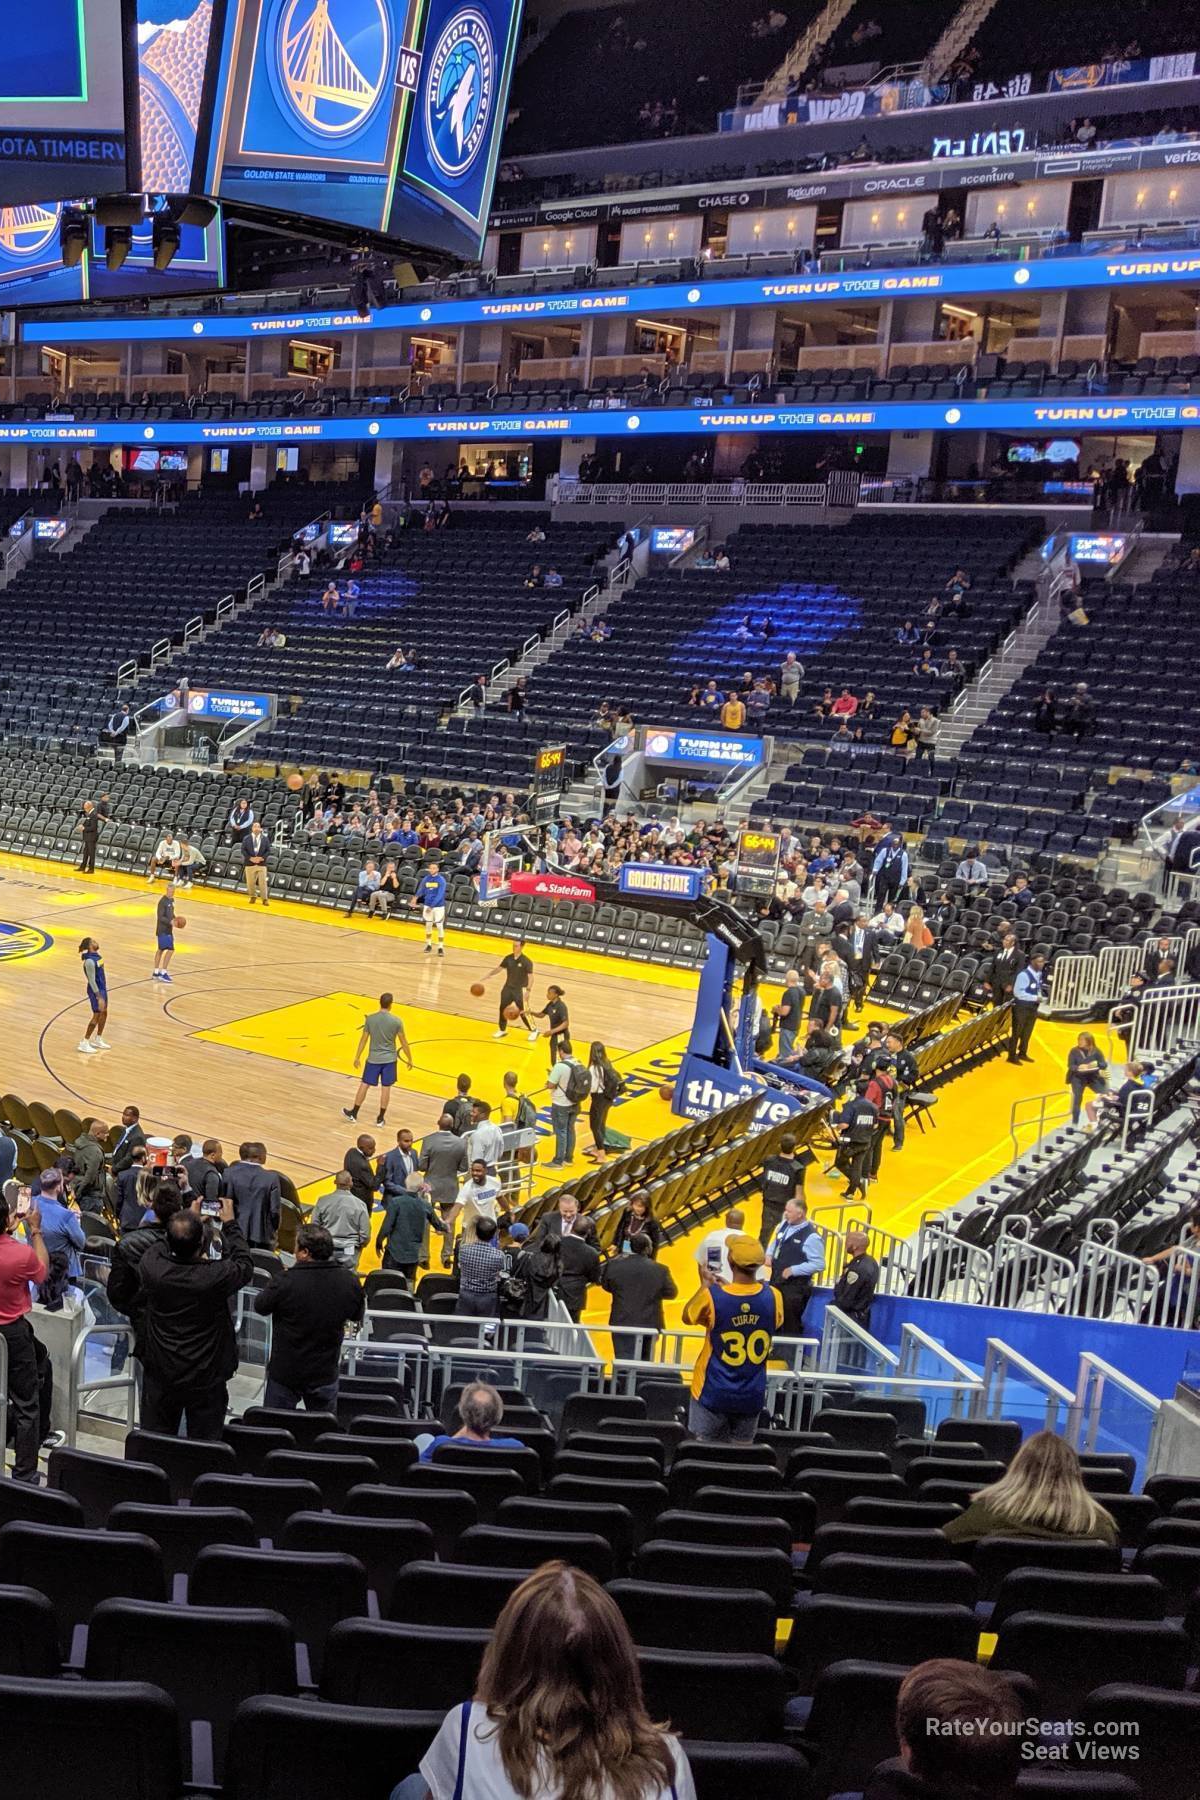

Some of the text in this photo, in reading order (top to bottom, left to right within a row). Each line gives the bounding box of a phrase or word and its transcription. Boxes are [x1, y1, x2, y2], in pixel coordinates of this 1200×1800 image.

[400, 52, 418, 85] VS
[430, 24, 469, 102] MINNESOTA
[1164, 150, 1200, 164] veriz
[244, 170, 326, 181] GOLDEN STATE WARRIORS
[960, 170, 1014, 185] accenture
[864, 176, 925, 191] ORACLE
[787, 186, 827, 199] Rakuten
[698, 195, 737, 207] CHASE
[501, 216, 533, 224] AIRLINES
[545, 208, 598, 222] Google Cloud
[1106, 260, 1200, 276] TURN UP
[762, 275, 940, 296] TURN UP THE GAME
[482, 296, 627, 314] TURN UP THE GAME
[251, 314, 371, 330] TURN UP THE GAME
[700, 412, 873, 425] TURN UP THE GAME
[1034, 408, 1094, 420] TURN
[1097, 407, 1128, 419] UP
[1131, 406, 1176, 419] THE
[203, 425, 321, 437] TURN UP THE GAME
[428, 419, 568, 431] TURN UP THE GAME
[11, 428, 28, 437] UP
[30, 429, 55, 437] THE
[58, 429, 95, 437] GAME
[210, 697, 255, 708] TURN UP
[679, 738, 743, 752] TURN UP
[679, 746, 754, 762] THE GAME
[744, 834, 776, 850] 66:44
[628, 868, 690, 893] GOLDEN STATE
[1137, 1102, 1149, 1110] 22
[767, 1170, 790, 1185] PHOTO
[731, 1315, 760, 1327] CURRY
[720, 1329, 772, 1367] 30
